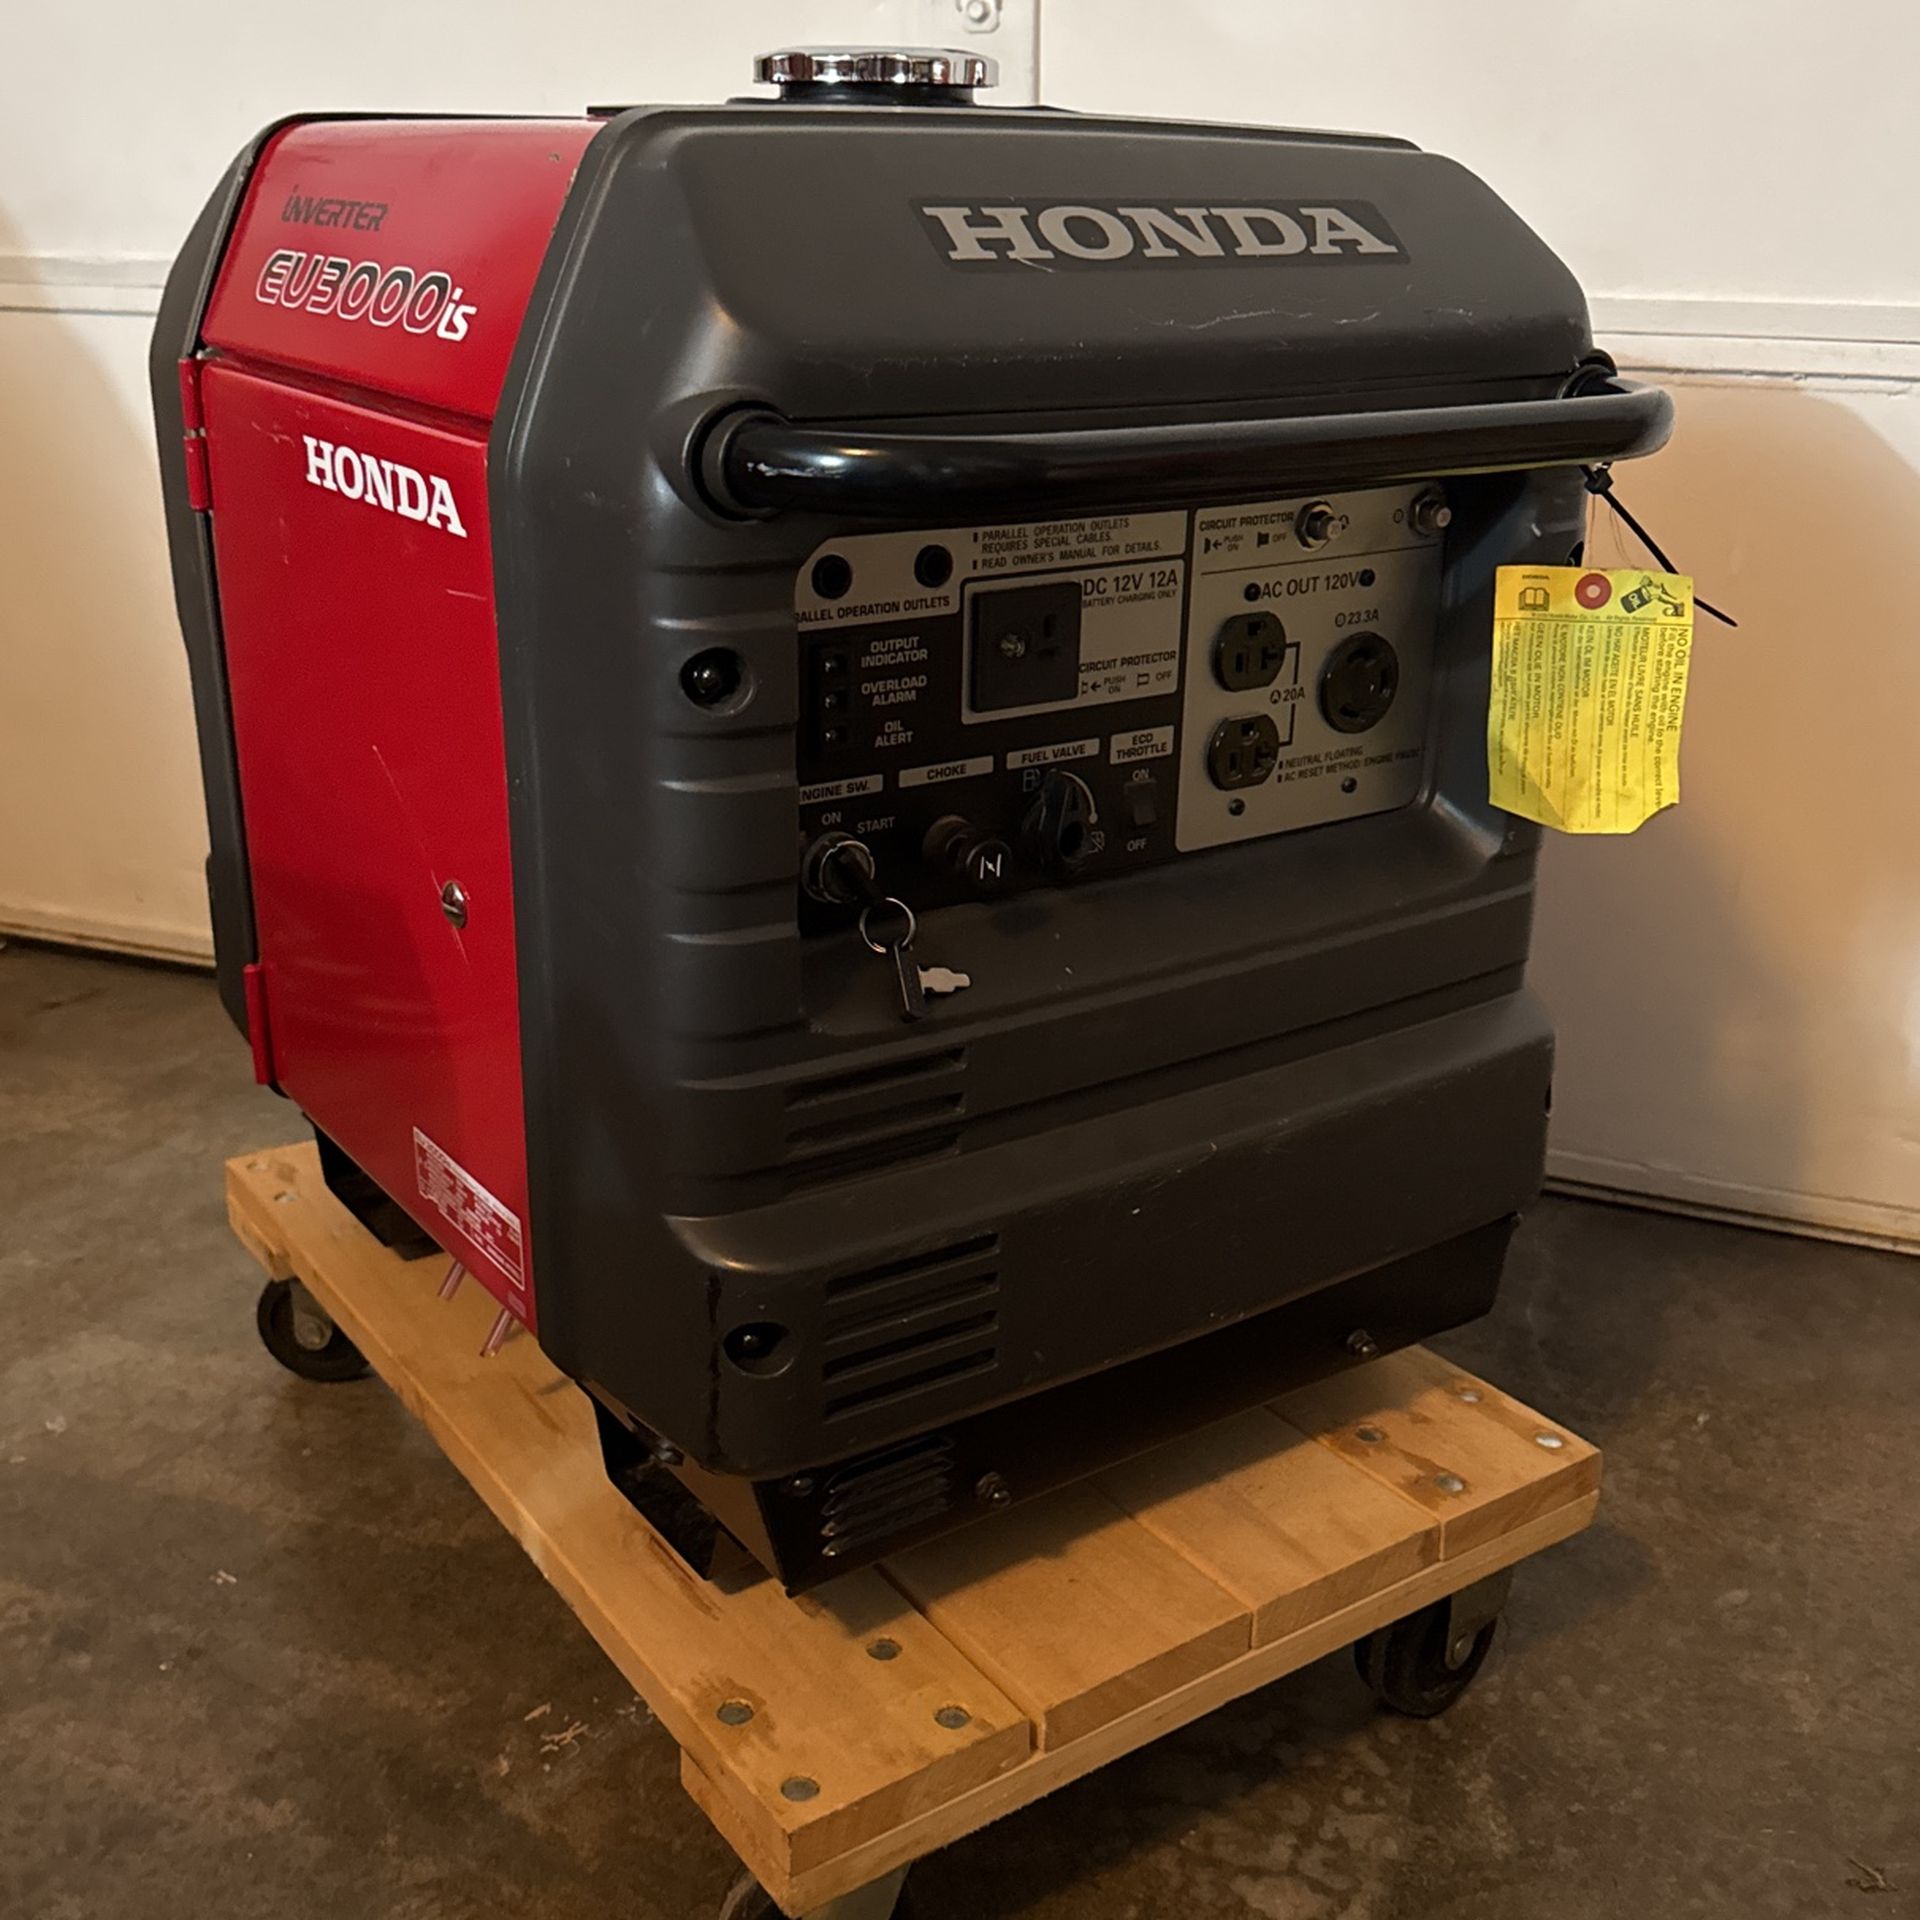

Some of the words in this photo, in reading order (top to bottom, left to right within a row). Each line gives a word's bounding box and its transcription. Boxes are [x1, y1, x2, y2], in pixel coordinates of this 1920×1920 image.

[922, 205, 1398, 260] HONDA
[256, 250, 477, 341] EU3000is
[303, 434, 467, 538] HONDA
[982, 528, 1028, 541] PARALLEL
[1034, 522, 1085, 536] OPERATION
[1091, 518, 1130, 531] OUTLETS
[1200, 518, 1237, 531] CIRCUIT
[1240, 512, 1294, 527] PROTECTOR
[982, 540, 1028, 554] REQUIRES
[1034, 536, 1070, 549] SPECIAL
[982, 557, 1007, 569] READ
[1012, 552, 1054, 566] OWNER'S
[1060, 548, 1096, 560] MANUAL
[1102, 545, 1120, 556] FOR
[1084, 577, 1108, 596] DC
[1113, 572, 1144, 592] 12V
[1150, 569, 1178, 588] 12A
[1261, 581, 1282, 599] AC
[1287, 576, 1320, 596] OUT
[1325, 571, 1359, 591] 120V
[837, 601, 900, 619] OPERATION
[904, 596, 950, 611] OUTLETS
[1348, 608, 1379, 625] 23.3A
[870, 636, 920, 653] OUTPUT
[1640, 627, 1650, 663] MOTEUR
[1658, 628, 1667, 656] before
[1677, 629, 1688, 646] NO
[861, 648, 928, 668] INDICATOR
[1666, 644, 1674, 658] the
[1674, 650, 1686, 668] OIL
[1079, 658, 1118, 673] CIRCUIT
[1120, 650, 1176, 667] PROTECTOR
[861, 675, 928, 695] OVERLOAD
[1652, 659, 1663, 693] starting
[1663, 660, 1671, 691] engine
[1673, 672, 1683, 684] IN
[872, 690, 916, 707] ALARM
[1283, 687, 1306, 702] 20A
[1633, 690, 1643, 712] SANS
[1651, 695, 1660, 710] the
[1660, 694, 1668, 712] with
[1666, 687, 1681, 731] ENGINE
[884, 720, 904, 733] OIL
[1630, 714, 1640, 738] HUILE
[874, 731, 914, 748] ALERT
[1132, 733, 1153, 745] ECO
[1022, 751, 1049, 764] FUEL
[1052, 744, 1086, 759] VALVE
[1116, 742, 1168, 760] THROTTLE
[927, 764, 967, 780] CHOKE
[1132, 768, 1149, 781] ON
[1654, 756, 1662, 786] correct
[802, 784, 843, 802] NGINE
[846, 779, 870, 793] SW.
[1655, 788, 1663, 808] leve
[821, 811, 842, 826] ON
[857, 816, 896, 834] START
[1127, 837, 1147, 851] OFF
